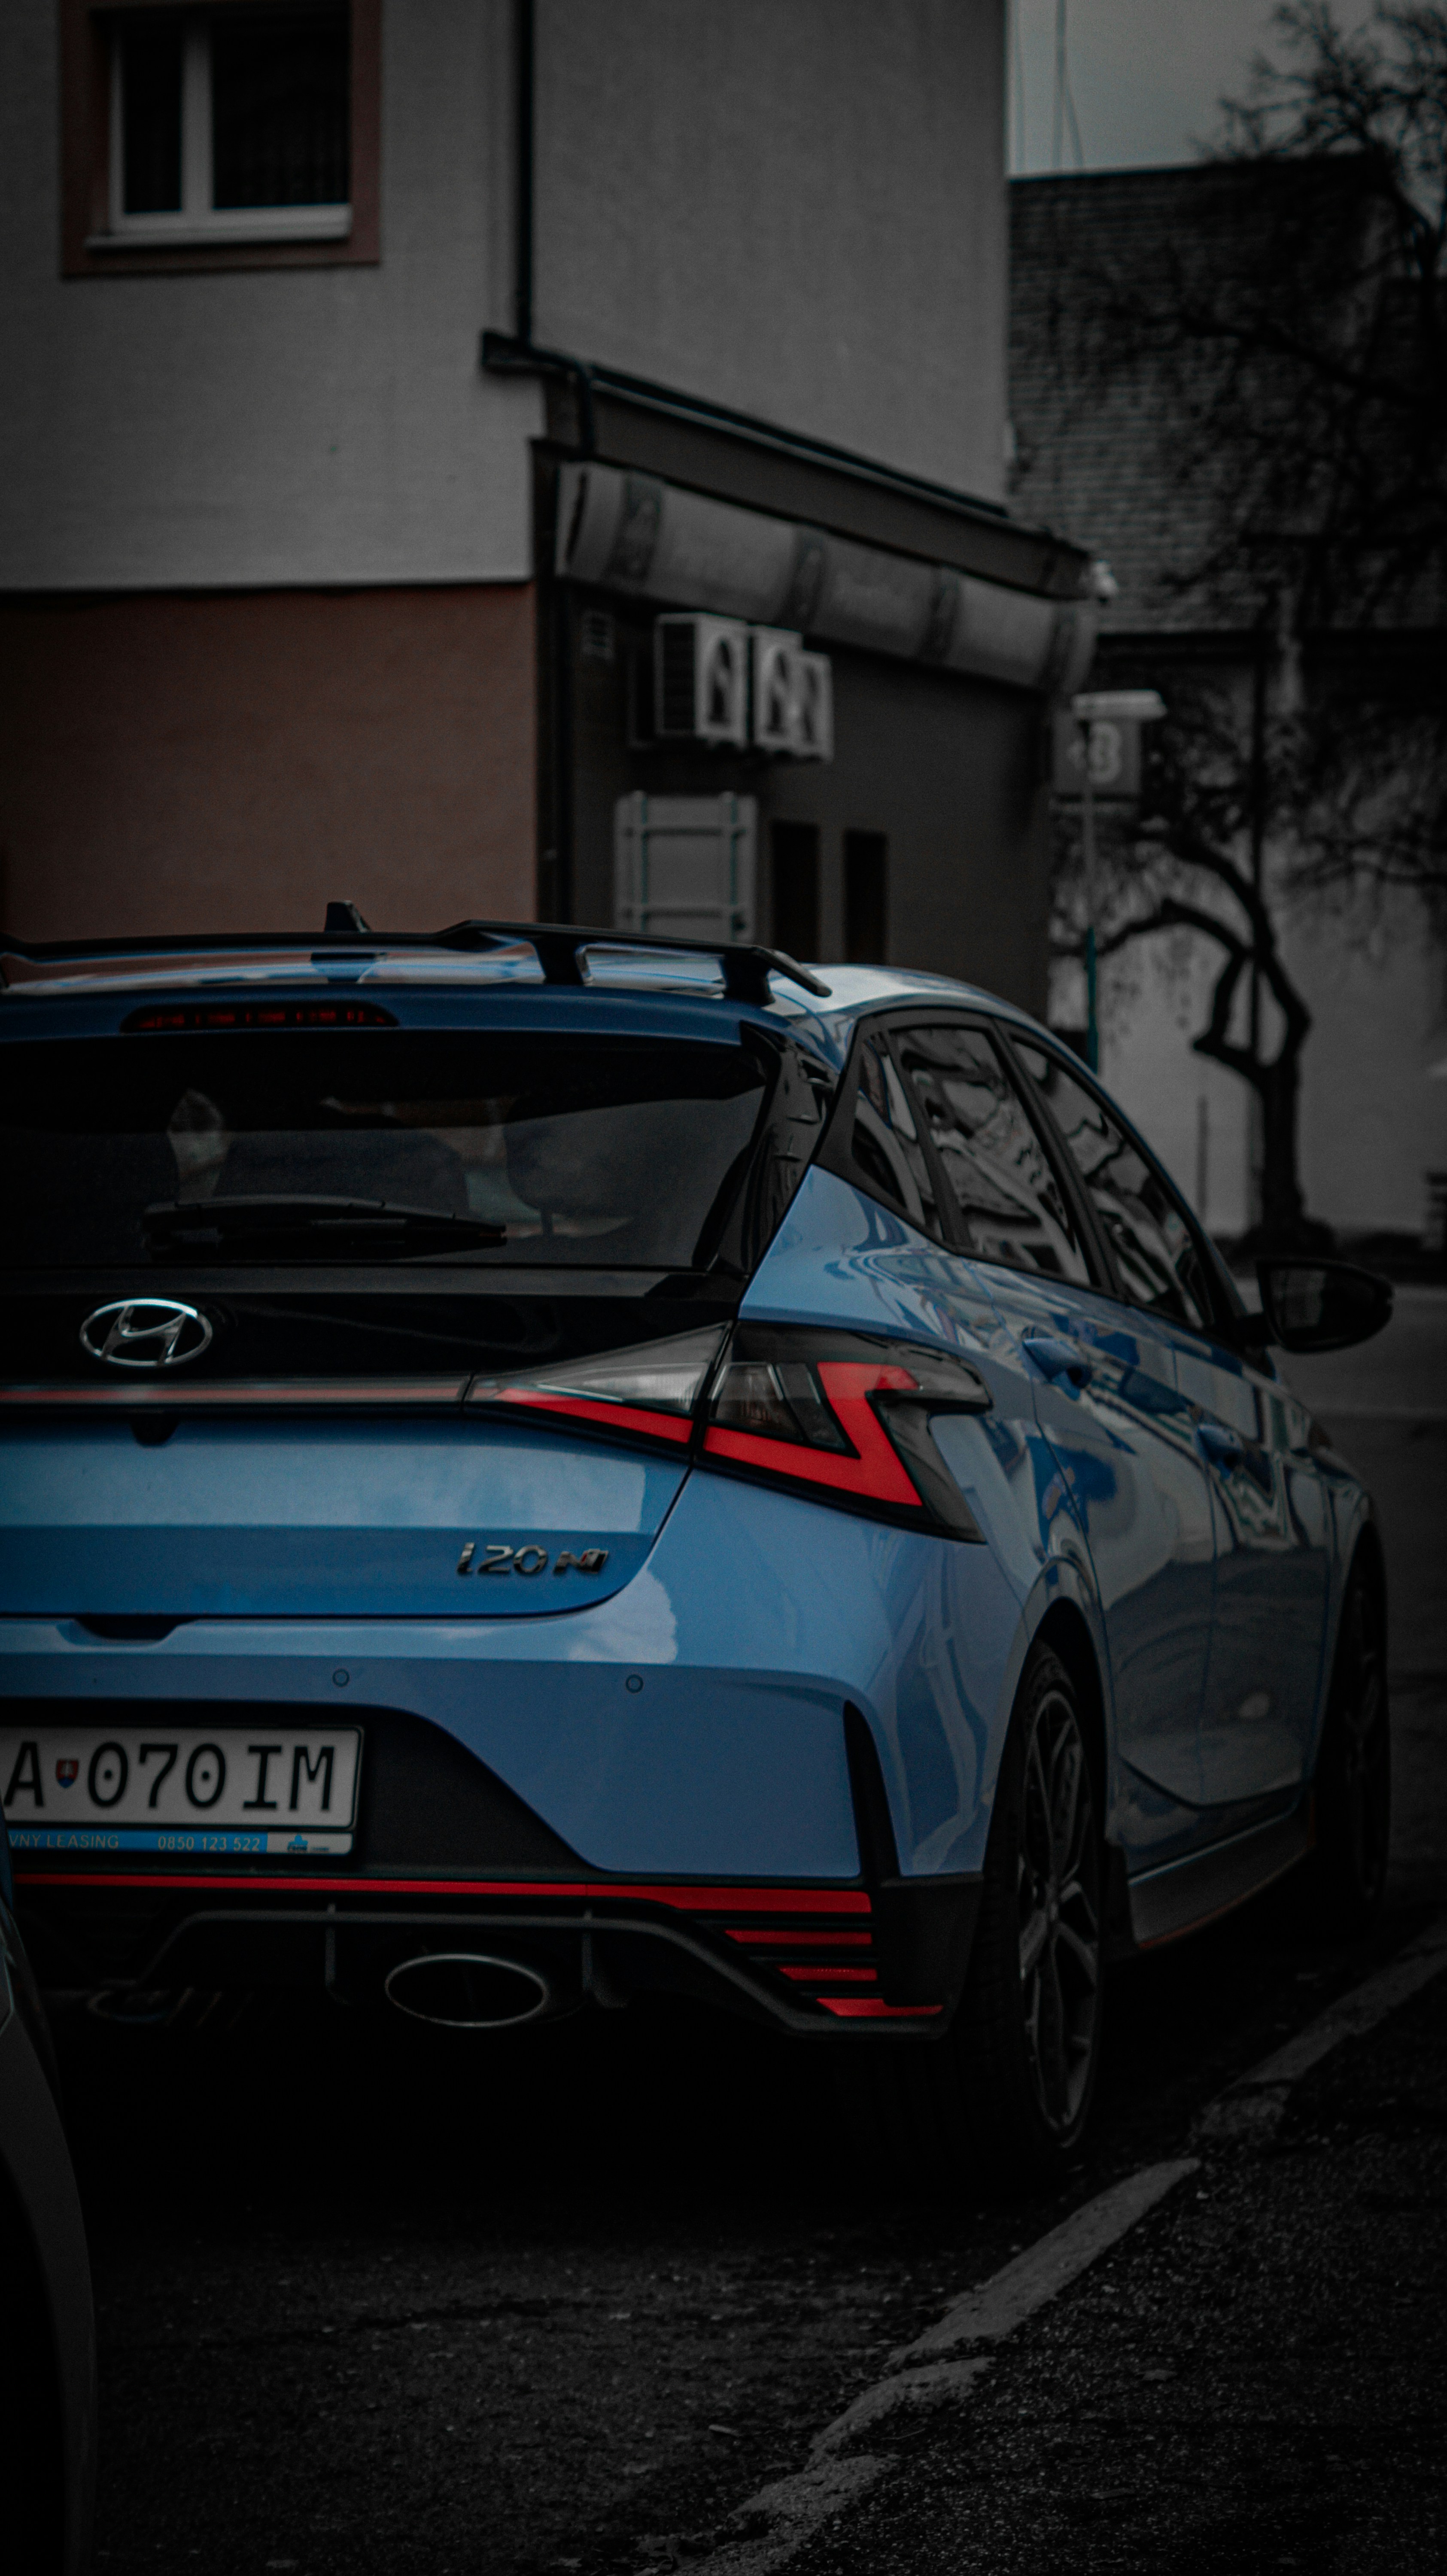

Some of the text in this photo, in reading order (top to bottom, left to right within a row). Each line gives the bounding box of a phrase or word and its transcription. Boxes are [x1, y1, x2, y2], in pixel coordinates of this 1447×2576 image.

[46, 1834, 119, 1849] LEASING
[157, 1835, 195, 1851] 0850
[202, 1836, 227, 1852] 123
[233, 1837, 261, 1853] 522
